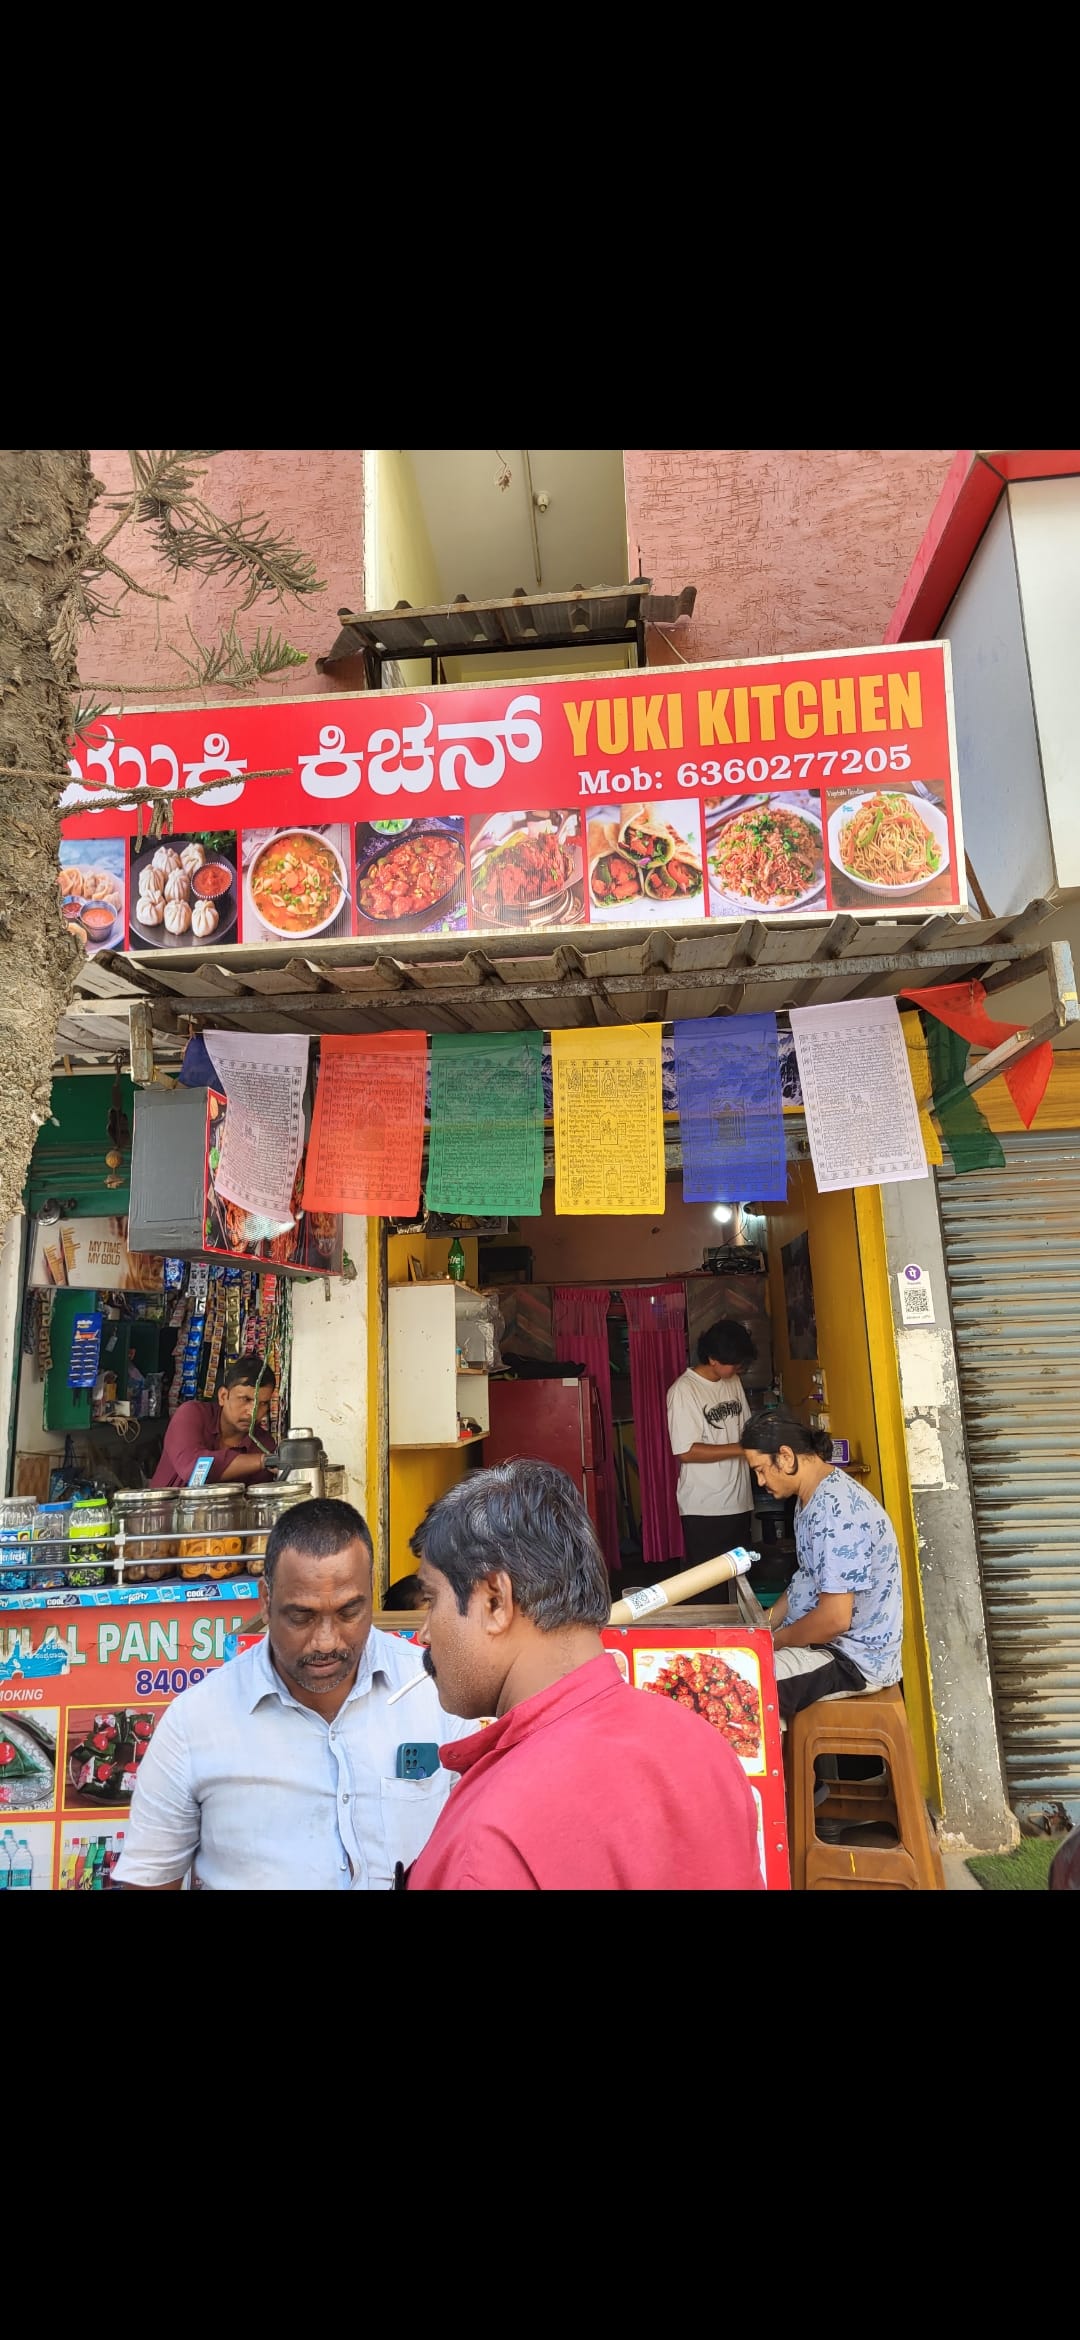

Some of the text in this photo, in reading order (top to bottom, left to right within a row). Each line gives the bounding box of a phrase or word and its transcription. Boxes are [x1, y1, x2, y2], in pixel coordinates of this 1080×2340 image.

[563, 671, 923, 757] YUKI KITCHEN
[298, 694, 544, 799] ಕಿಚನ್
[578, 744, 912, 796] Mob: 6360277205
[88, 1252, 121, 1266] MY GOLD
[89, 1240, 121, 1254] MY TIME
[97, 1620, 179, 1664] PAN
[191, 1614, 243, 1661] SH
[136, 1665, 223, 1696] 8409
